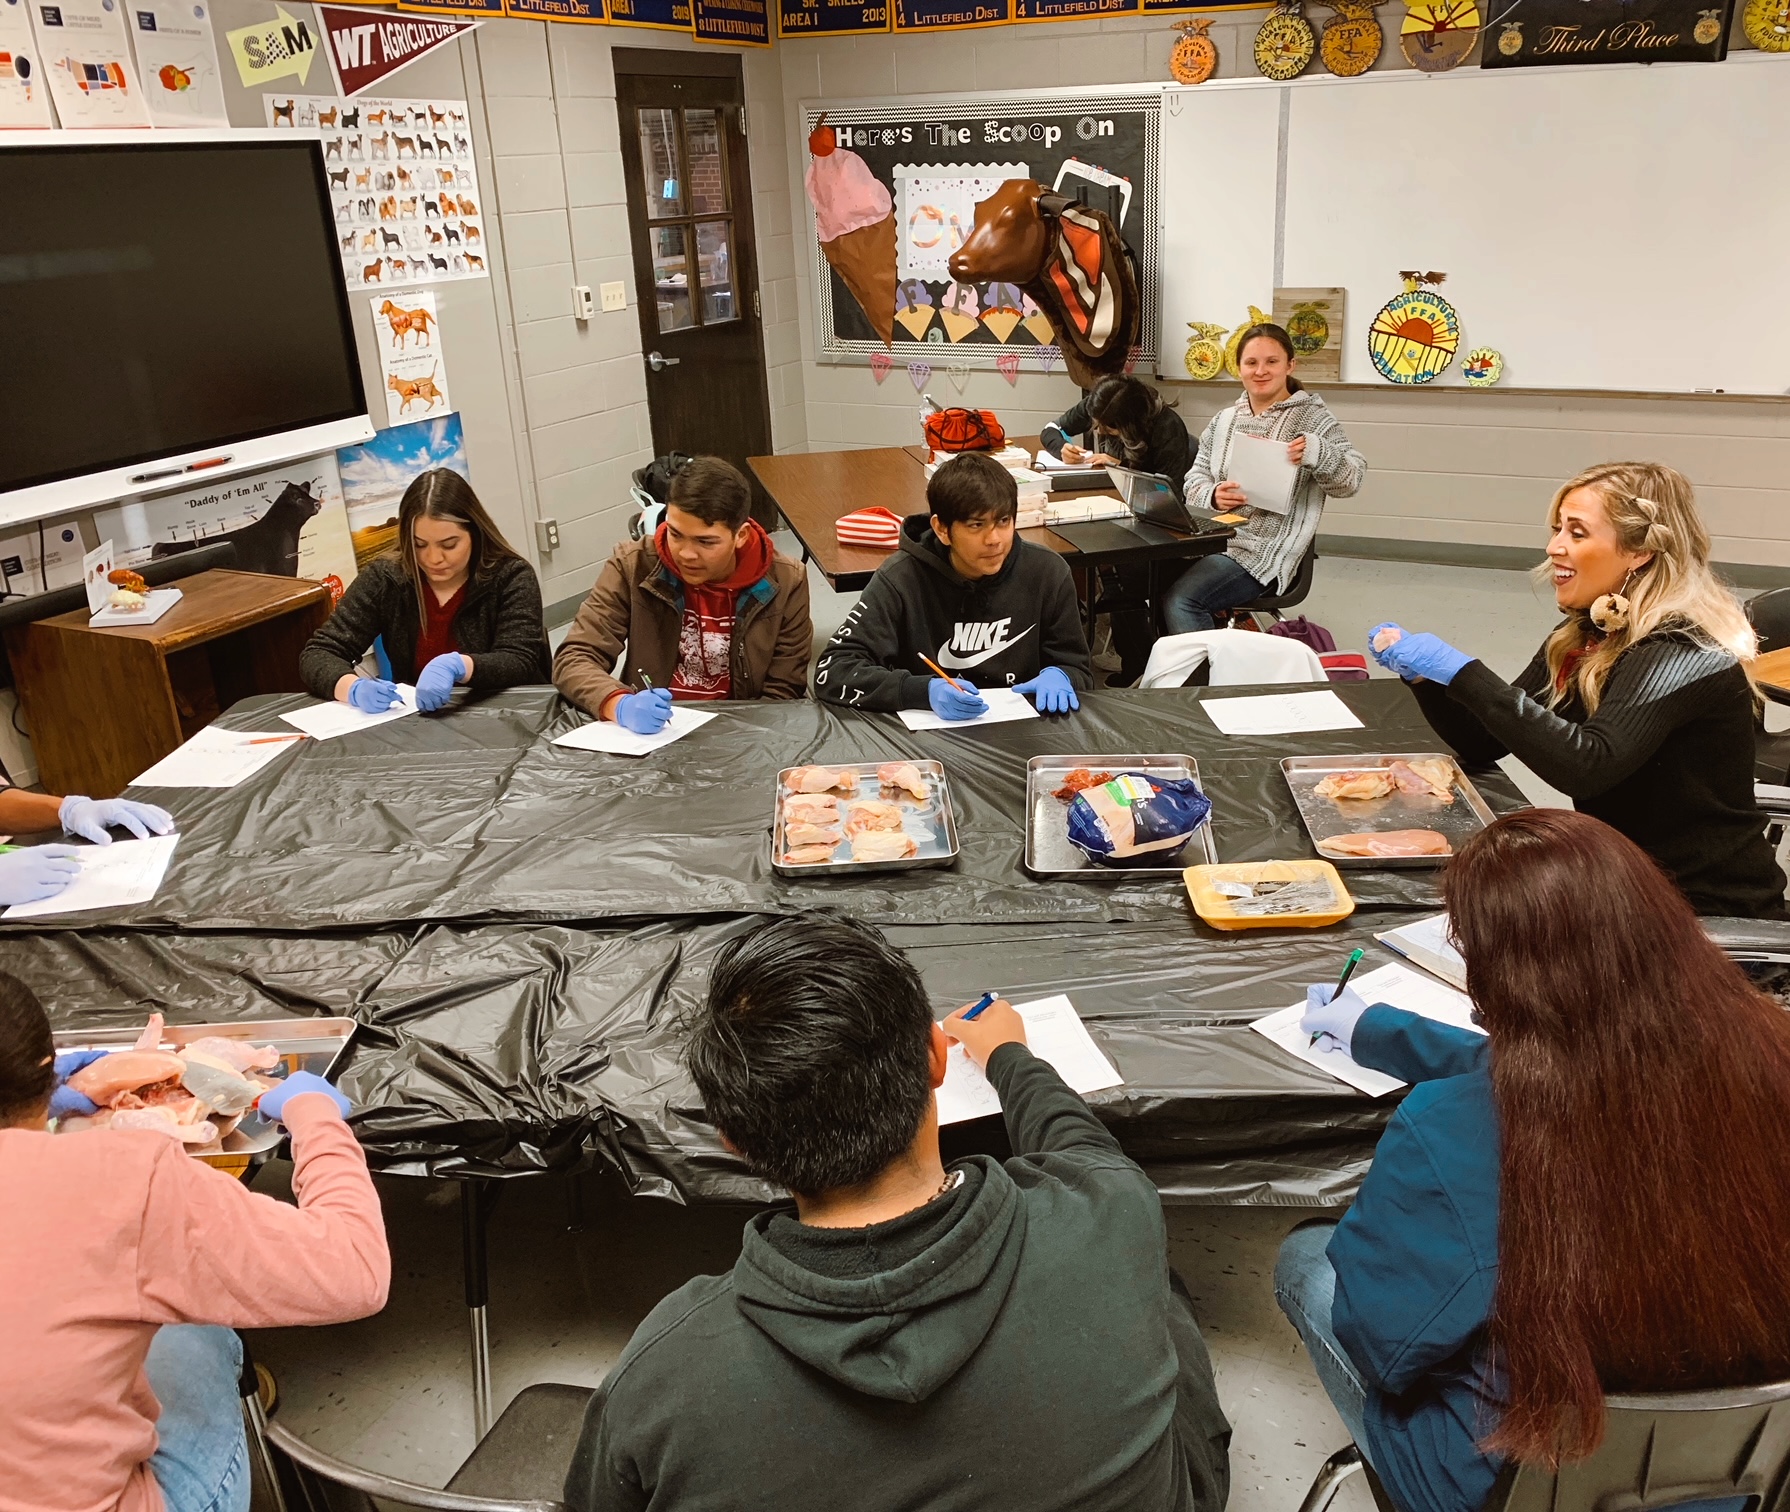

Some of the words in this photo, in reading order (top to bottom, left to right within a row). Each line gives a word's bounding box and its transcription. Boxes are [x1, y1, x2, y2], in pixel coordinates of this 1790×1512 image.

[612, 0, 630, 15] AREA
[672, 5, 690, 20] 2019
[862, 7, 886, 23] 2013
[1018, 3, 1026, 17] 4
[1035, 1, 1097, 15] LITTLEFIELD
[705, 17, 751, 35] LITTLEFIELD
[782, 13, 811, 27] AREA
[898, 12, 906, 26] 4
[914, 11, 973, 25] LITTLEFIELD
[1273, 32, 1296, 46] FFA
[1338, 28, 1363, 40] FFA
[1533, 24, 1606, 55] Third
[1607, 19, 1680, 50] Place
[1760, 26, 1790, 43] EDUCAT
[243, 21, 313, 69] SAM
[332, 23, 377, 71] WT
[378, 22, 458, 63] AGRICULTURE
[1183, 49, 1202, 58] FFA
[1332, 51, 1369, 68] EDUCATION
[1075, 116, 1115, 141] On
[1388, 292, 1458, 337] AGRICULTURAL
[1410, 306, 1436, 322] FFA
[1373, 350, 1435, 383] EDUCATION
[222, 490, 231, 500] of
[950, 616, 1012, 652] NIKE
